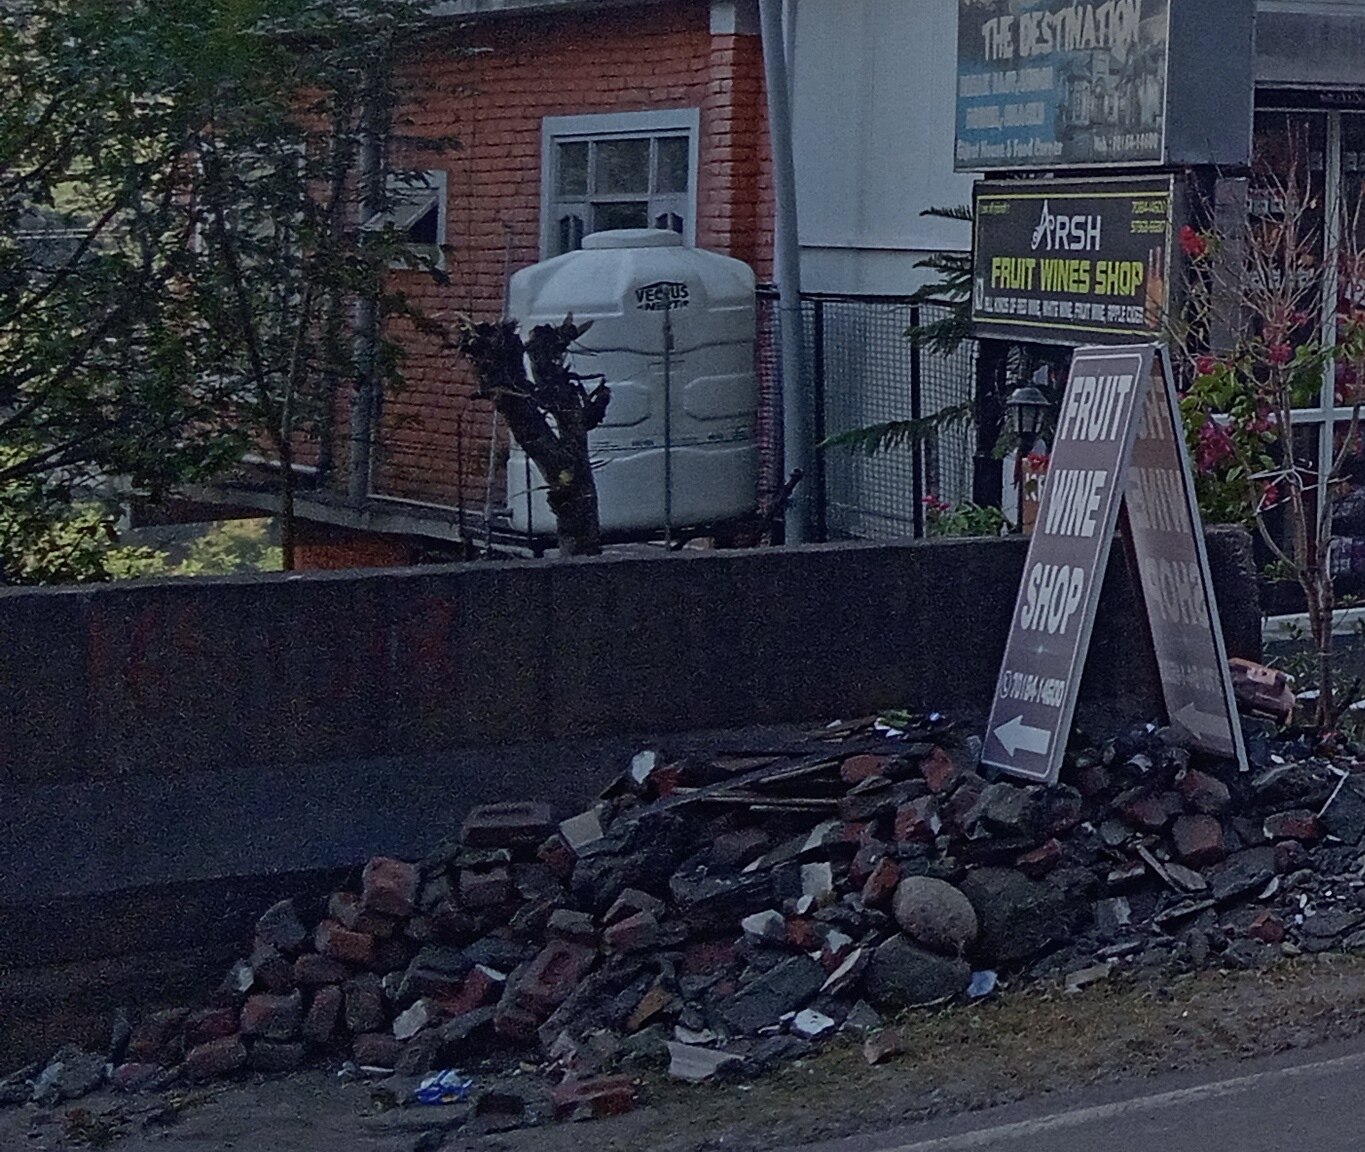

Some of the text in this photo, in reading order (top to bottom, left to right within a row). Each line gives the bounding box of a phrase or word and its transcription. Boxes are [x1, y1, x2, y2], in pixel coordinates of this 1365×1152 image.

[982, 15, 1014, 61] THE
[1031, 199, 1102, 251] ARSH
[991, 257, 1144, 296] FRUIT WINES SHOP
[1059, 374, 1134, 442] FRUIT
[1044, 470, 1108, 538] WINE
[1020, 562, 1085, 635] SHOP
